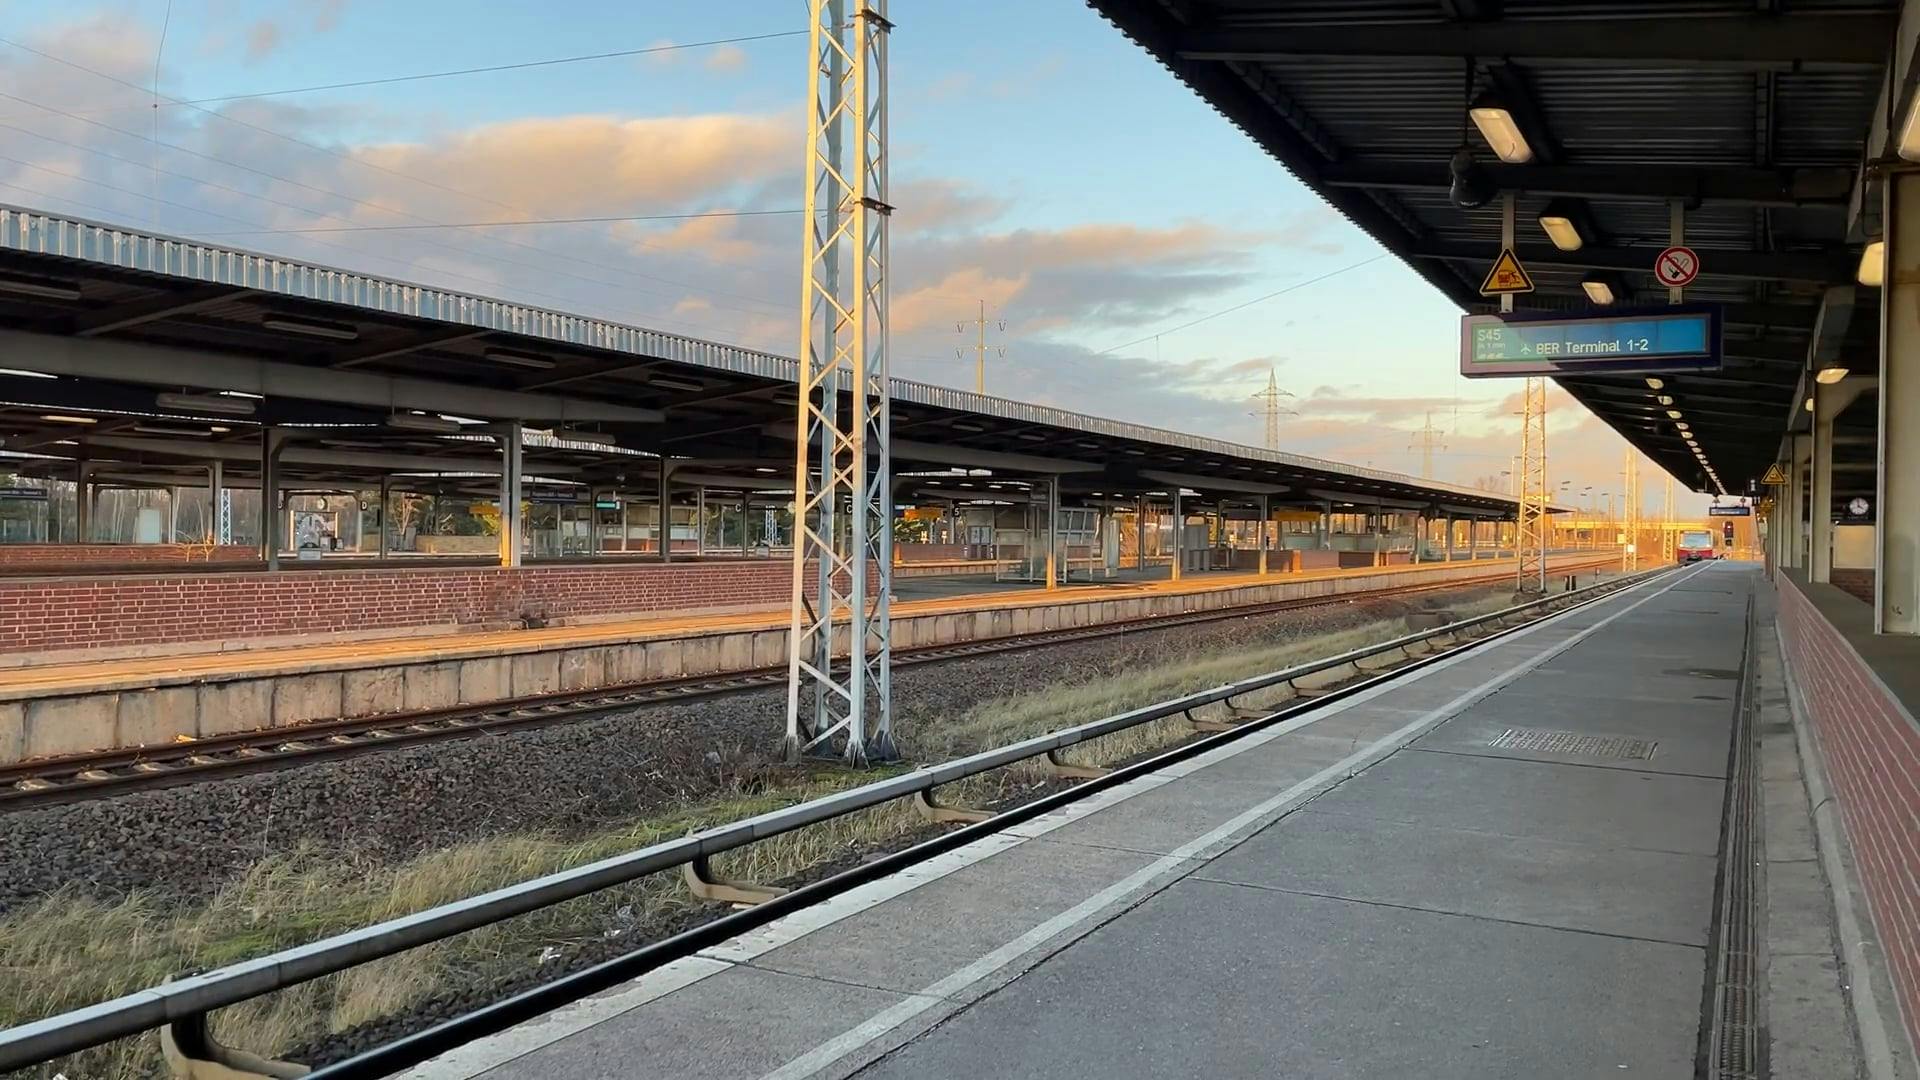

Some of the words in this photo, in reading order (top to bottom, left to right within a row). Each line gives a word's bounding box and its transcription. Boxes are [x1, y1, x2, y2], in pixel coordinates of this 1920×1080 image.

[1478, 329, 1501, 342] S45
[1536, 342, 1560, 354] BER
[1566, 339, 1620, 353] Terminal
[1627, 338, 1649, 351] 1-2
